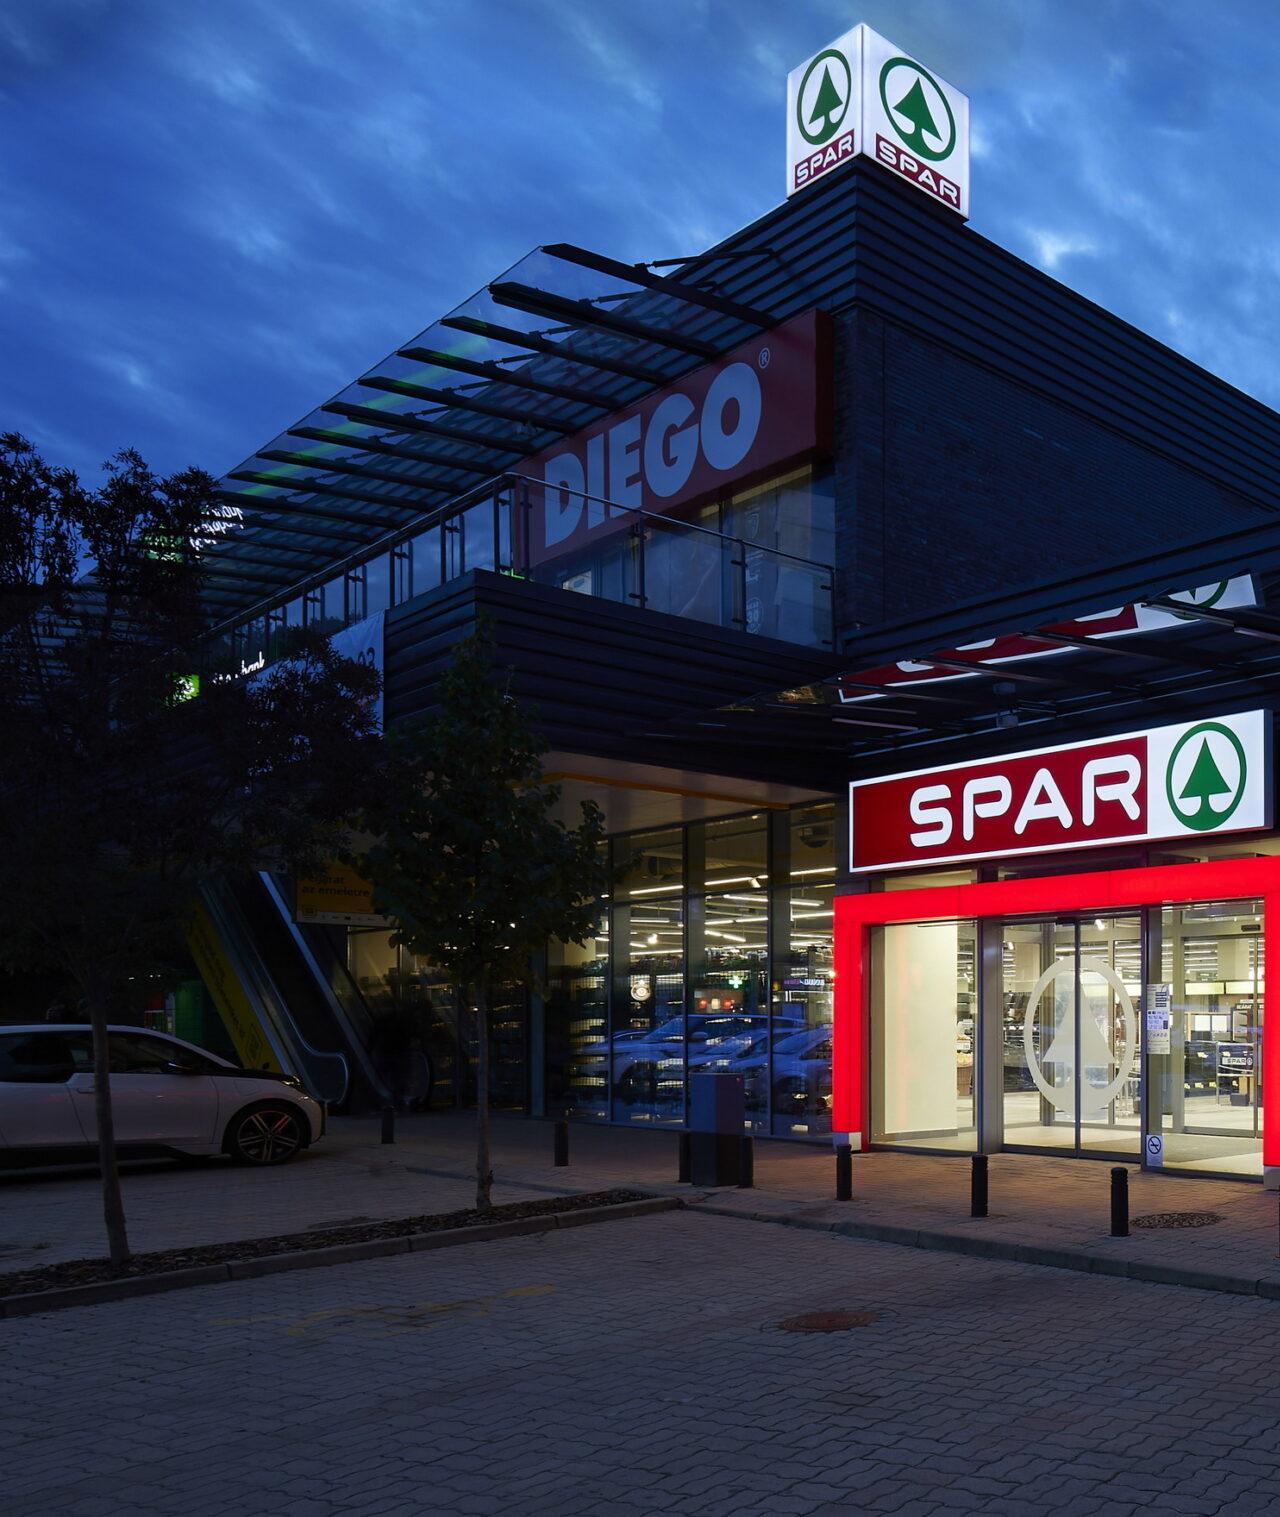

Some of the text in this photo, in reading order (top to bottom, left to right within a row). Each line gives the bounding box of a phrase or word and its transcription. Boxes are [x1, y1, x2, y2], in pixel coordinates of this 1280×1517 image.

[796, 134, 853, 184] SPAR
[878, 140, 958, 204] SPAR
[909, 754, 1141, 848] SPAR
